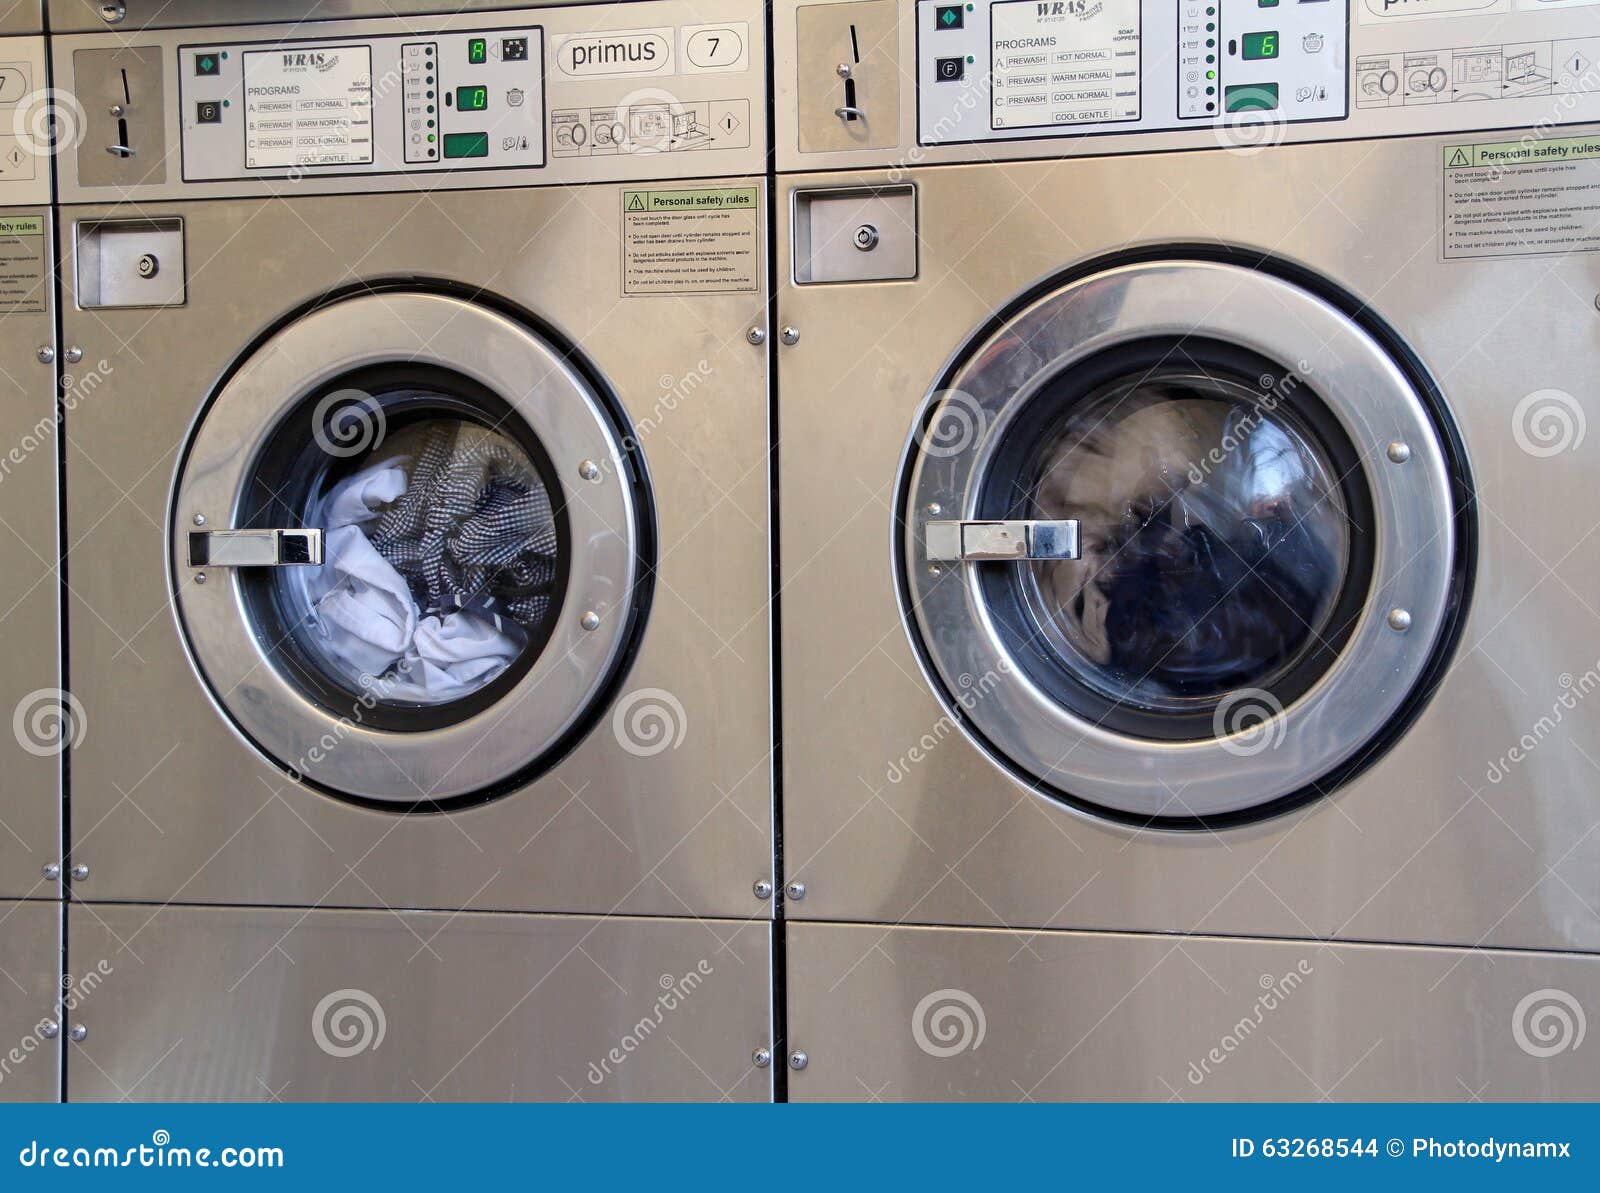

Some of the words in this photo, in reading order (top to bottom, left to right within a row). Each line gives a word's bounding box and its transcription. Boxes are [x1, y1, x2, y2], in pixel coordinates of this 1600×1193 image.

[1037, 0, 1085, 16] WRAS
[472, 42, 484, 59] A
[707, 38, 720, 57] 7
[995, 37, 1057, 50] PROGRAMS
[1261, 35, 1275, 56] 6
[283, 53, 324, 67] WRAS
[572, 40, 656, 71] primus
[1008, 56, 1046, 65] PREWASH
[1074, 51, 1107, 60] NORMAL
[1008, 76, 1046, 85] PREWASH
[1052, 74, 1077, 82] WARM
[1078, 71, 1111, 80] NORMAL
[248, 86, 300, 96] PROGRAMS
[473, 89, 485, 107] 0
[1008, 95, 1046, 105] PREWASH
[1054, 93, 1075, 101] COOL
[1076, 91, 1109, 99] NORMAL
[315, 100, 344, 108] NORMAL
[1055, 113, 1077, 121] COOL
[1078, 111, 1109, 119] GENTLE
[260, 139, 292, 147] PREWASH
[318, 136, 347, 144] NORMAL
[1480, 149, 1530, 161] Personal
[1534, 146, 1569, 157] safety
[1572, 144, 1600, 154] rules
[653, 197, 694, 206] Personal
[696, 196, 724, 206] safety
[726, 195, 750, 204] rules
[16, 223, 37, 231] rules
